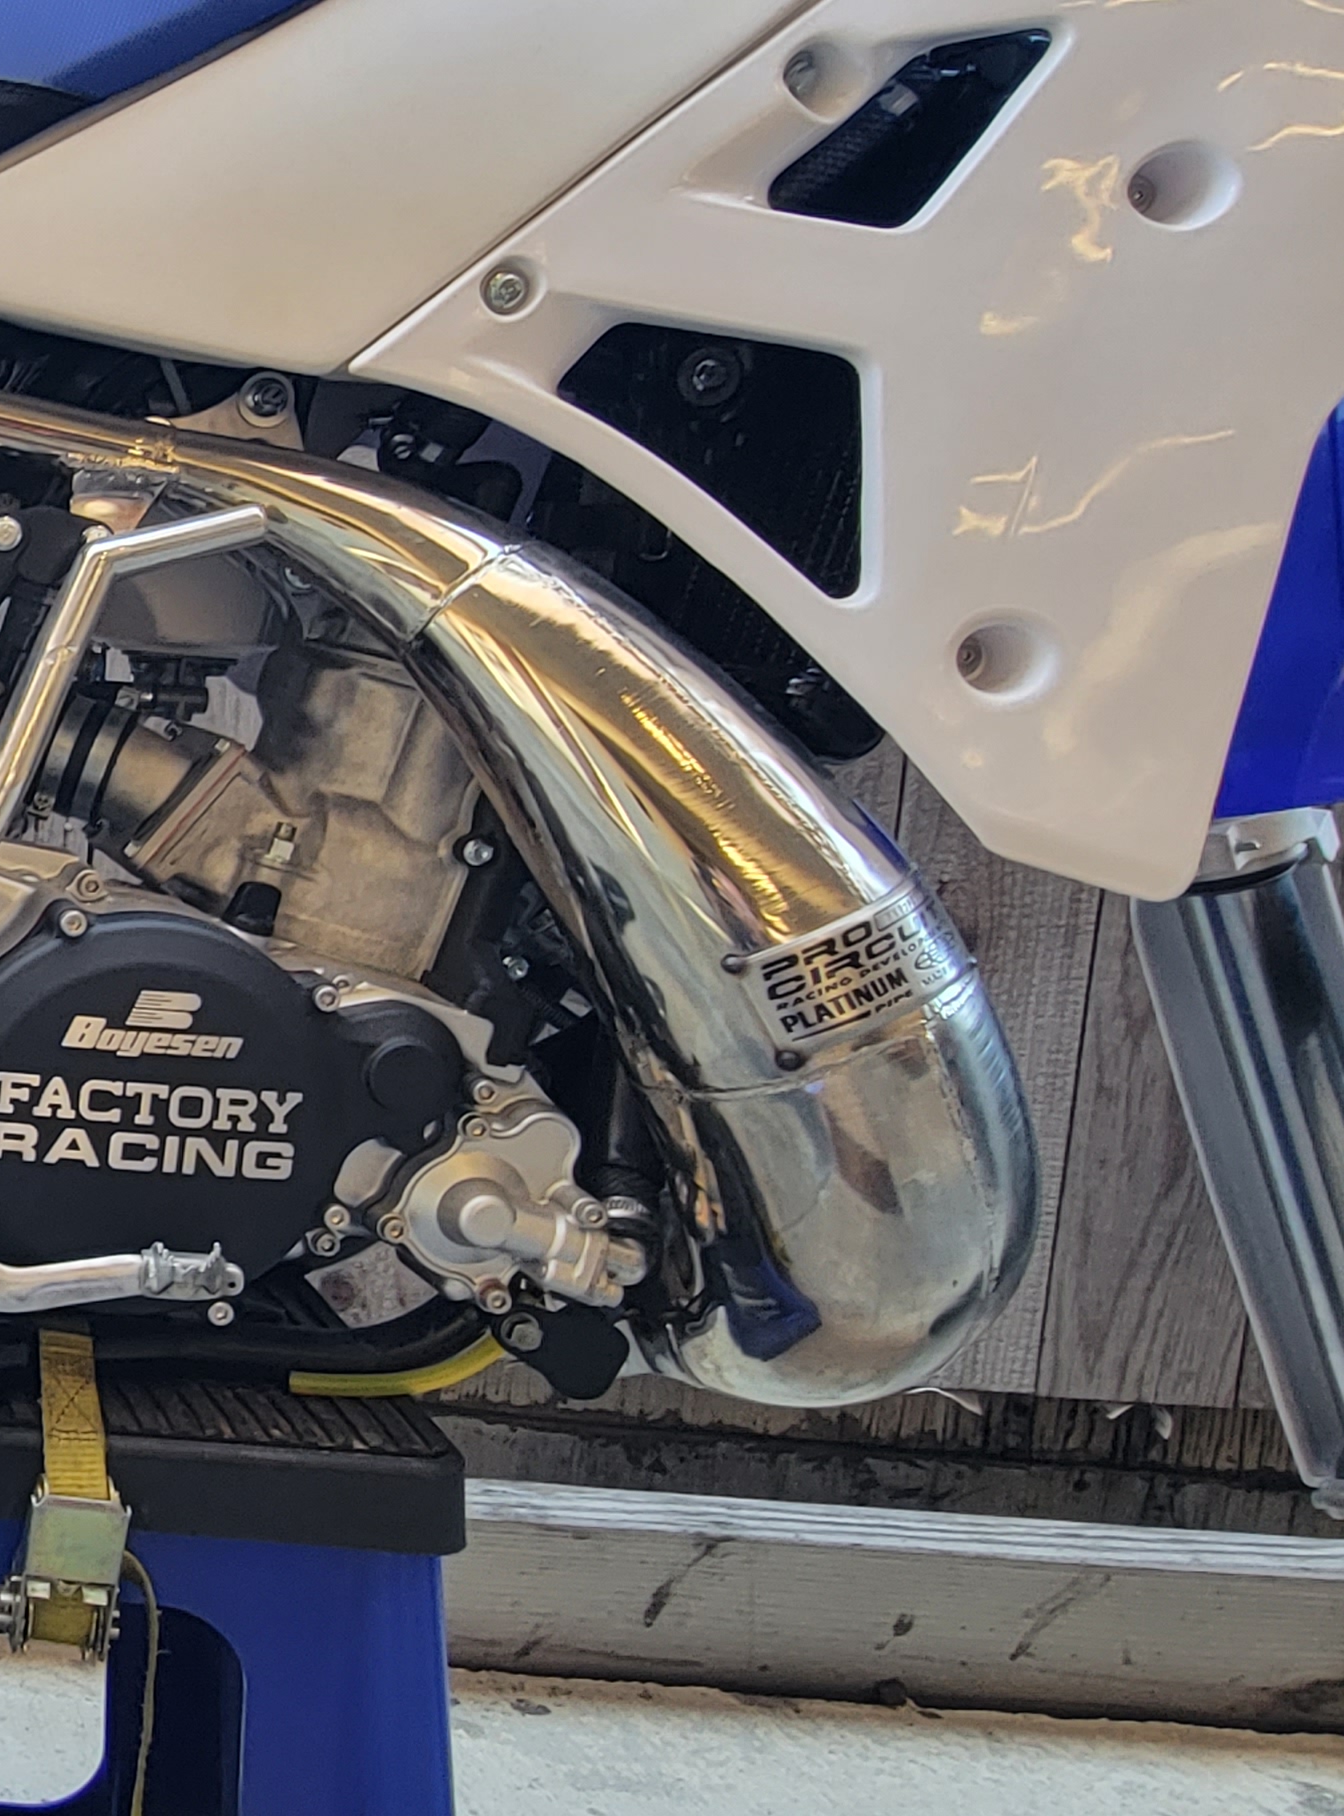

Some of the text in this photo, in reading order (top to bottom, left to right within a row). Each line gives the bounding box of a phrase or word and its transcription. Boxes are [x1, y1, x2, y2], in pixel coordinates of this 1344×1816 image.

[760, 920, 873, 982] PRO
[775, 976, 853, 1012] RACING
[779, 966, 909, 1034] PLATINUM
[61, 1014, 244, 1060] Boyesen
